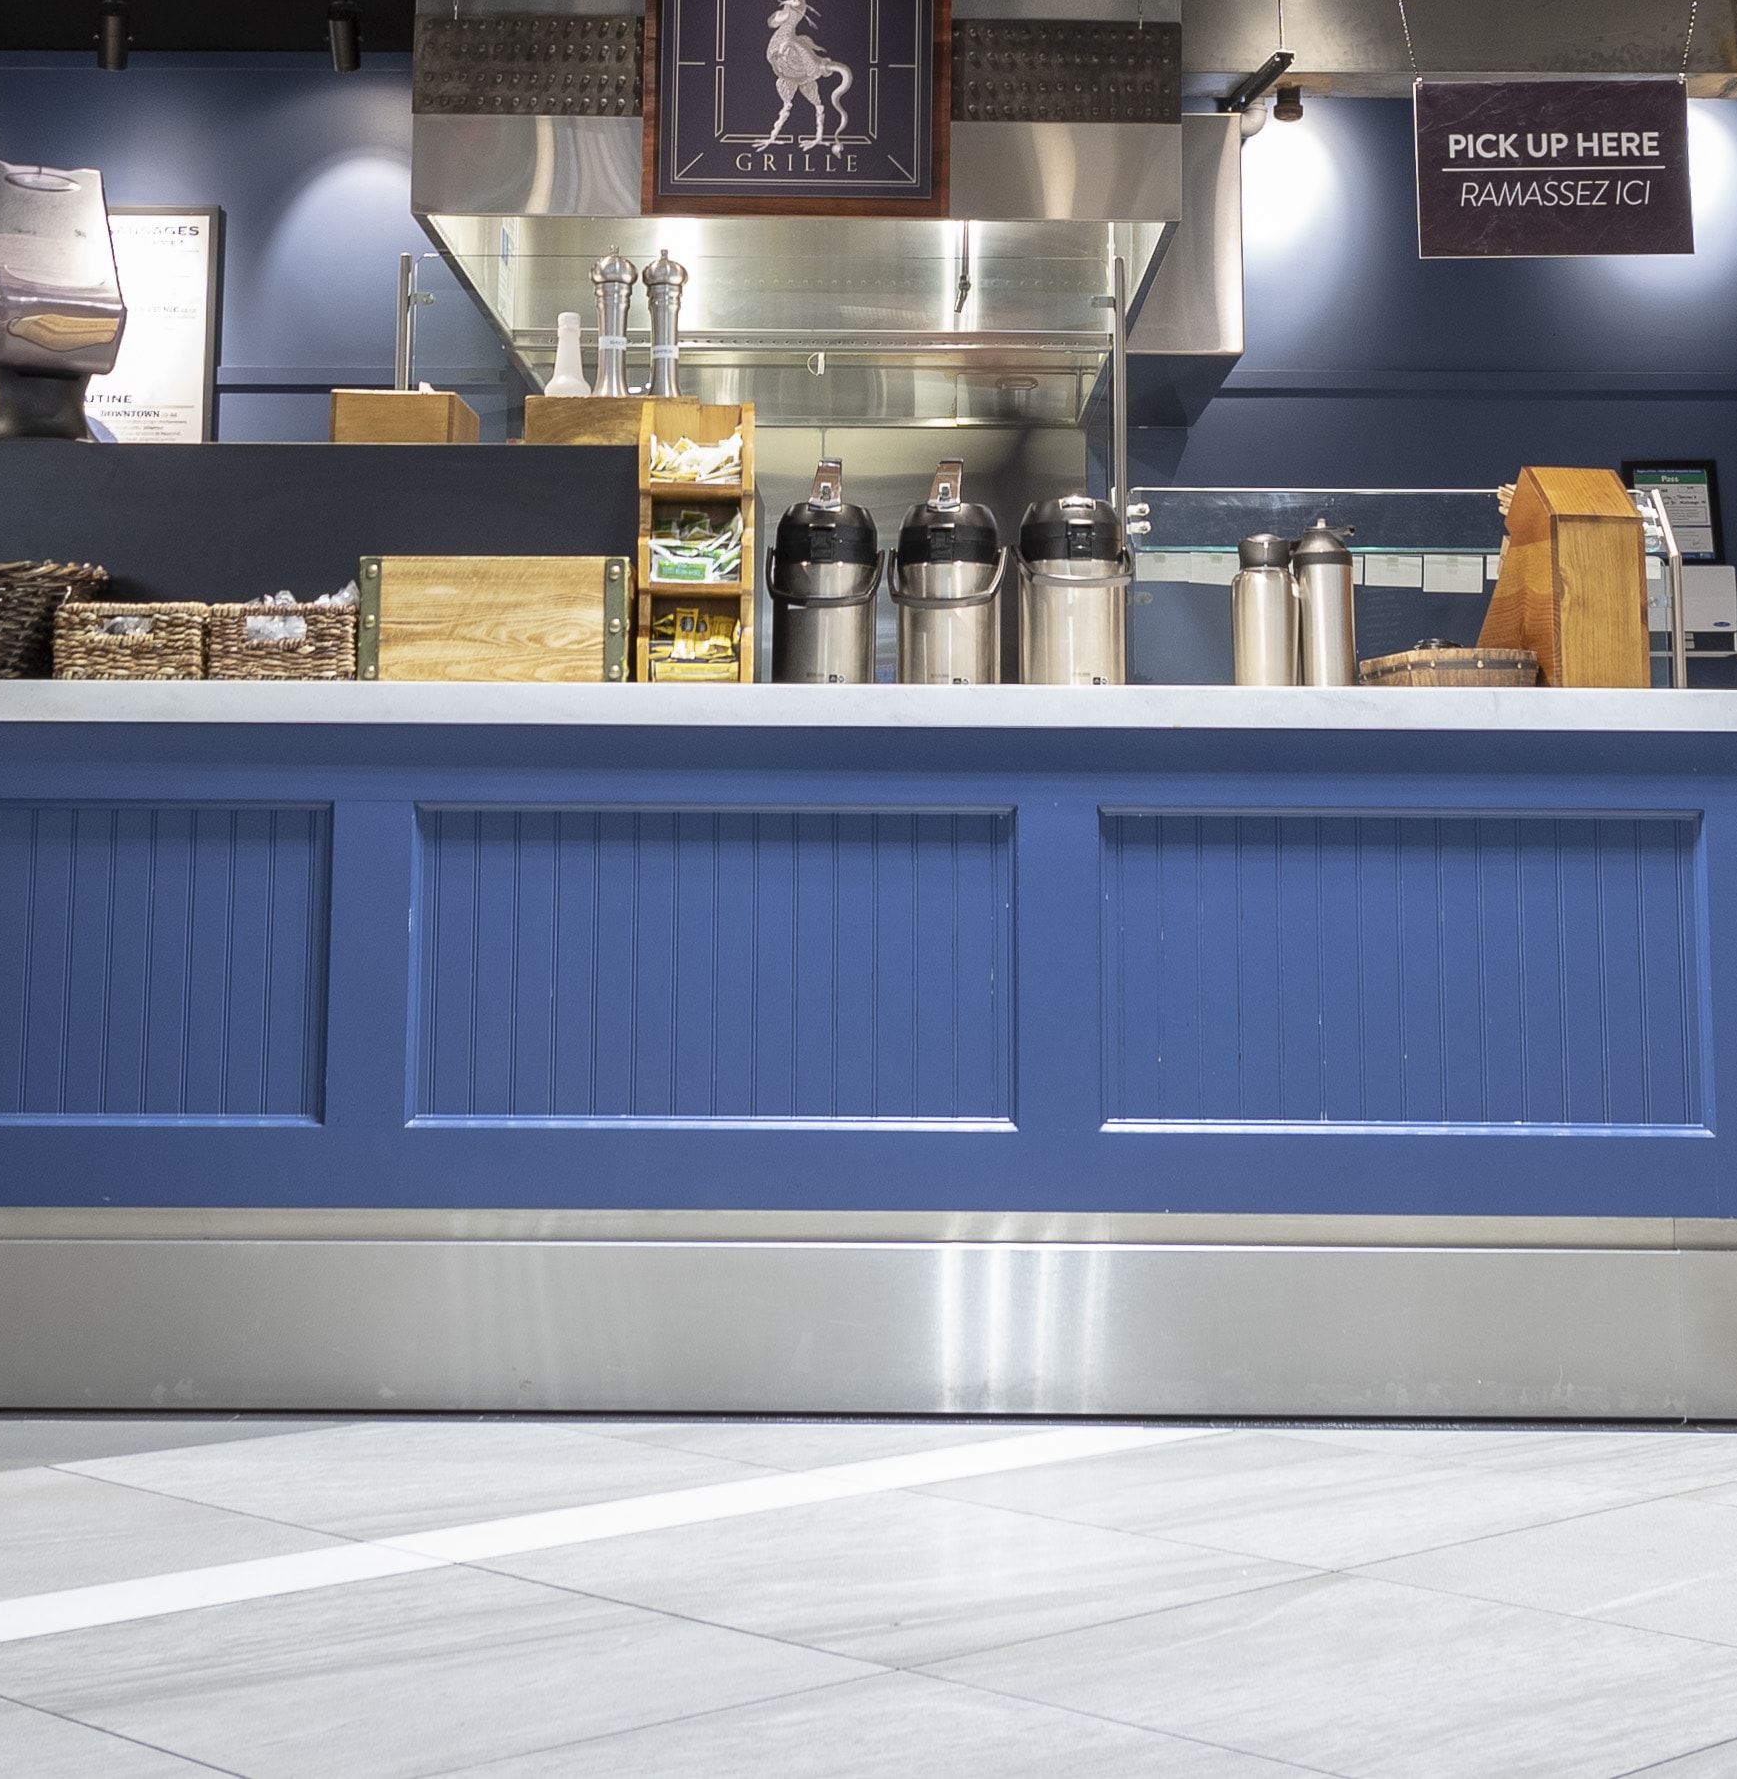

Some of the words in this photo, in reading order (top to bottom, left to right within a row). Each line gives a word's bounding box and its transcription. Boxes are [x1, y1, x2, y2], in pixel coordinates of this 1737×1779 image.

[1448, 133, 1519, 158] PICK
[1527, 133, 1568, 158] UP
[1577, 132, 1660, 157] HERE
[736, 153, 857, 172] GRILLE
[1461, 181, 1610, 207] RAMASSEZ
[1616, 180, 1650, 205] ICI
[1661, 475, 1679, 483] Pass
